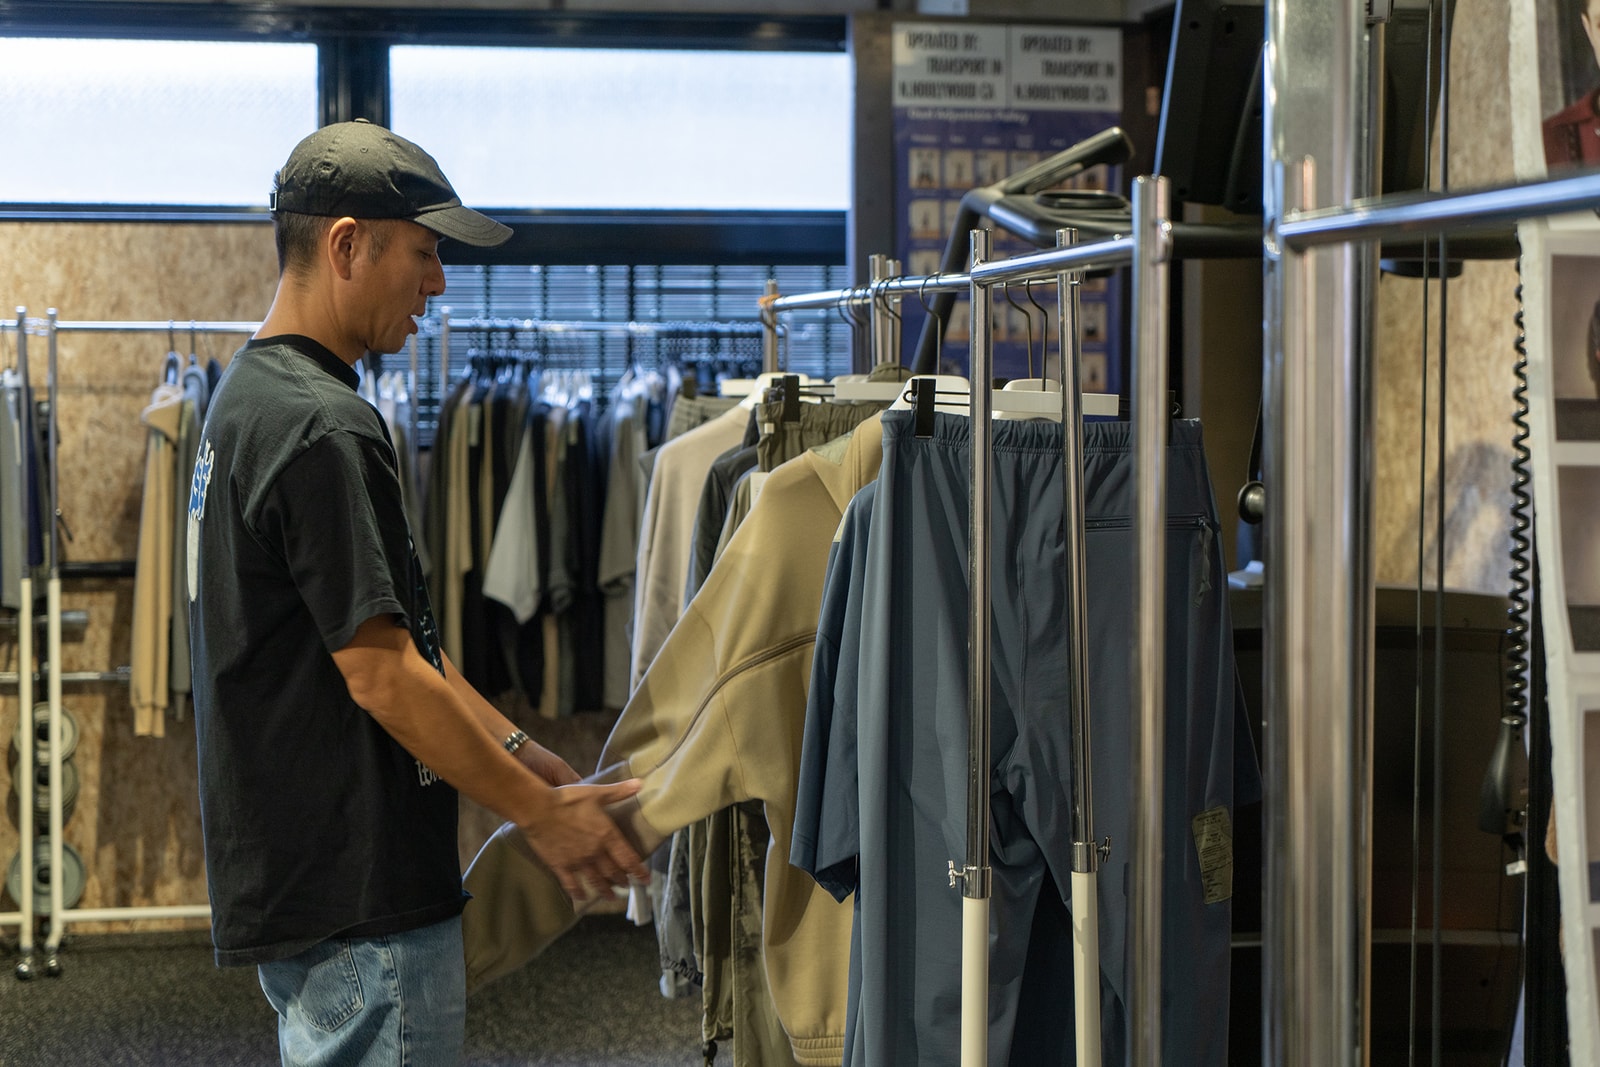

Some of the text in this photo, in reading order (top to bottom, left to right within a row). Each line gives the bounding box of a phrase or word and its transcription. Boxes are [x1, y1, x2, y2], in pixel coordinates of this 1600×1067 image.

[907, 31, 958, 49] OPERATED
[1022, 35, 1072, 53] OPERATED
[928, 56, 987, 74] TRANSPORT
[1043, 59, 1099, 77] TRANSPORT
